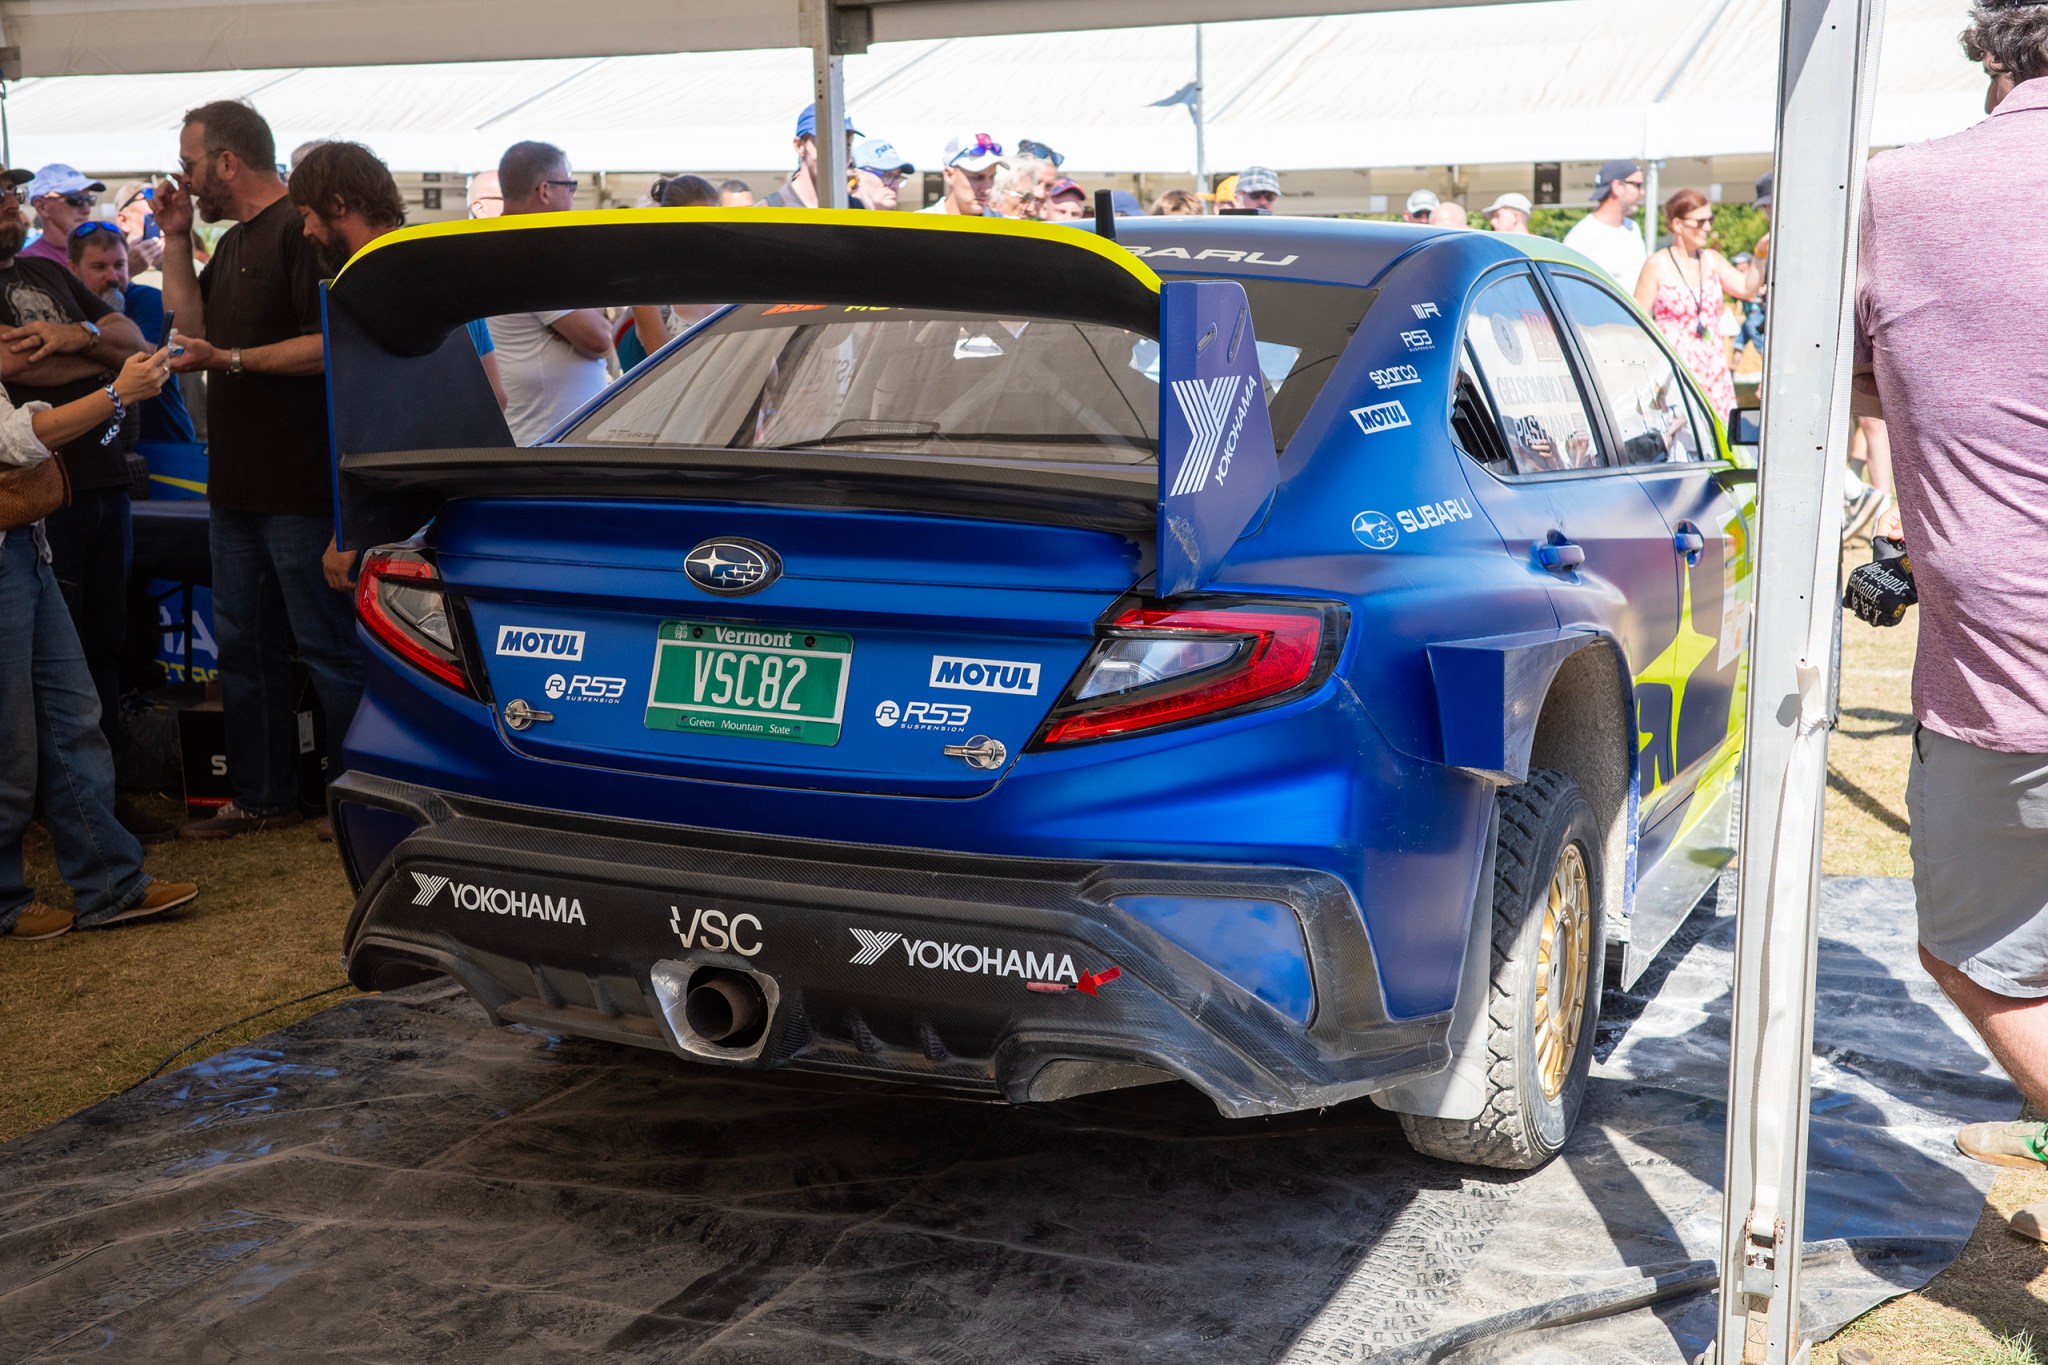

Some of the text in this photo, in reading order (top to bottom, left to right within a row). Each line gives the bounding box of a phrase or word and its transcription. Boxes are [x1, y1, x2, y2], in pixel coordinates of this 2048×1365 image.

[1400, 329, 1433, 348] R53
[1369, 364, 1419, 389] sparco
[1358, 405, 1408, 430] MOTUL
[1215, 375, 1258, 486] YOKOHAMA
[1396, 497, 1473, 533] SUBARU
[500, 630, 579, 656] MOTUL
[715, 626, 792, 648] Vermont
[567, 674, 627, 698] R53
[693, 649, 808, 711] VSC82
[935, 661, 1034, 690] MOTUL
[565, 695, 620, 704] SUSPENSION
[689, 716, 791, 735] Green Mountain State
[902, 701, 972, 726] R53
[900, 723, 965, 733] SUSPENSION
[448, 881, 587, 926] YOKOHAMA
[669, 905, 763, 957] VSC
[901, 938, 1079, 983] YOKOHAMA
